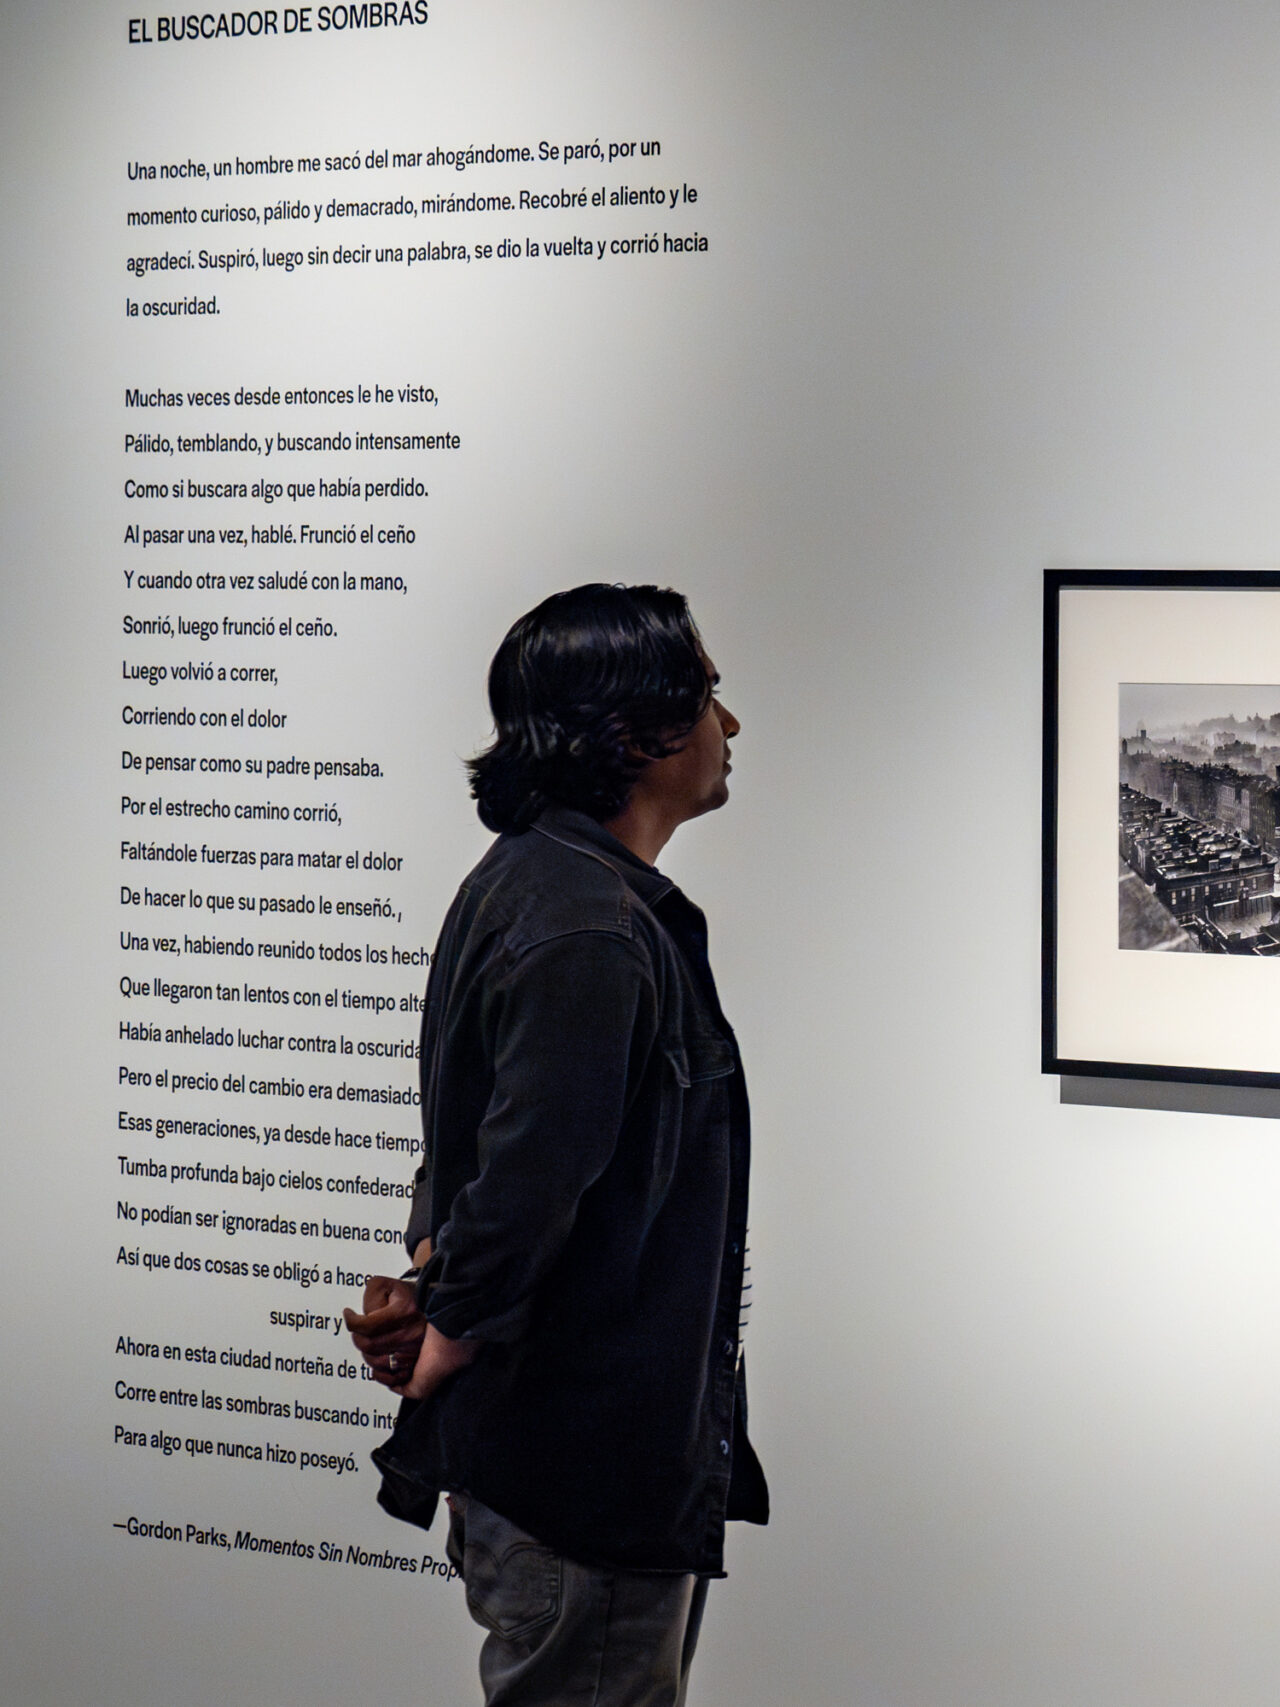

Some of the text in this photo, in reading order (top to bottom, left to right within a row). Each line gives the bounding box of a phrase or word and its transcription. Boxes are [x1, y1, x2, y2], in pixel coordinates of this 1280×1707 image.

[128, 0, 429, 45] EL BUSCADOR DE SOMBRAS
[127, 137, 661, 181] Una noche, un hombre me sacó del mar ahogándome. Se paró, por un
[126, 231, 709, 278] agradecí. Suspiró, luego sin decir una palabra, se dio la vuelta y corrió hacia
[126, 295, 221, 317] la oscuridad.
[125, 383, 439, 408] Muchas veces desde entonces le he visto,
[124, 476, 429, 505] Como si buscara algo que había perdido.
[123, 523, 416, 549] Al pasar una vez, hablé. Frunció el ceño
[122, 614, 338, 642] Sonrió, luego frunció el ceño.
[122, 660, 278, 687] Luego volvió a correr,
[121, 705, 288, 729] Corriendo con el dolor
[121, 795, 342, 827] Por el estrecho camino corrió,
[120, 840, 404, 872] Faltándole fuerzas para matar el dolor
[120, 885, 333, 917] De hacer lo que su pasado le
[120, 930, 389, 965] Una vez, habiendo reunido todos los
[119, 975, 396, 1016] Que llegaron tan lentos con el tiempo
[119, 1020, 354, 1055] Había anhelado luchar contra la
[118, 1110, 373, 1149] Esas generaciones, ya desde hace
[117, 1155, 168, 1179] Tumba
[170, 1161, 239, 1185] profunda
[242, 1165, 276, 1193] bajo
[278, 1169, 324, 1192] cielos
[116, 1200, 371, 1242] No podían ser ignoradas en buena
[116, 1245, 333, 1289] Así que dos cosas se obligó a
[269, 1309, 331, 1333] suspirar
[114, 1335, 357, 1380] Ahora en esta ciudad norteña de
[114, 1379, 370, 1427] Corre entre las sombras buscando
[114, 1424, 359, 1476] Para algo que nunca hizo poseyó.
[185, 1523, 232, 1552] Parks,
[233, 1530, 316, 1560] Momentos
[317, 1541, 344, 1563] Sin
[345, 1544, 418, 1573] Nombres
